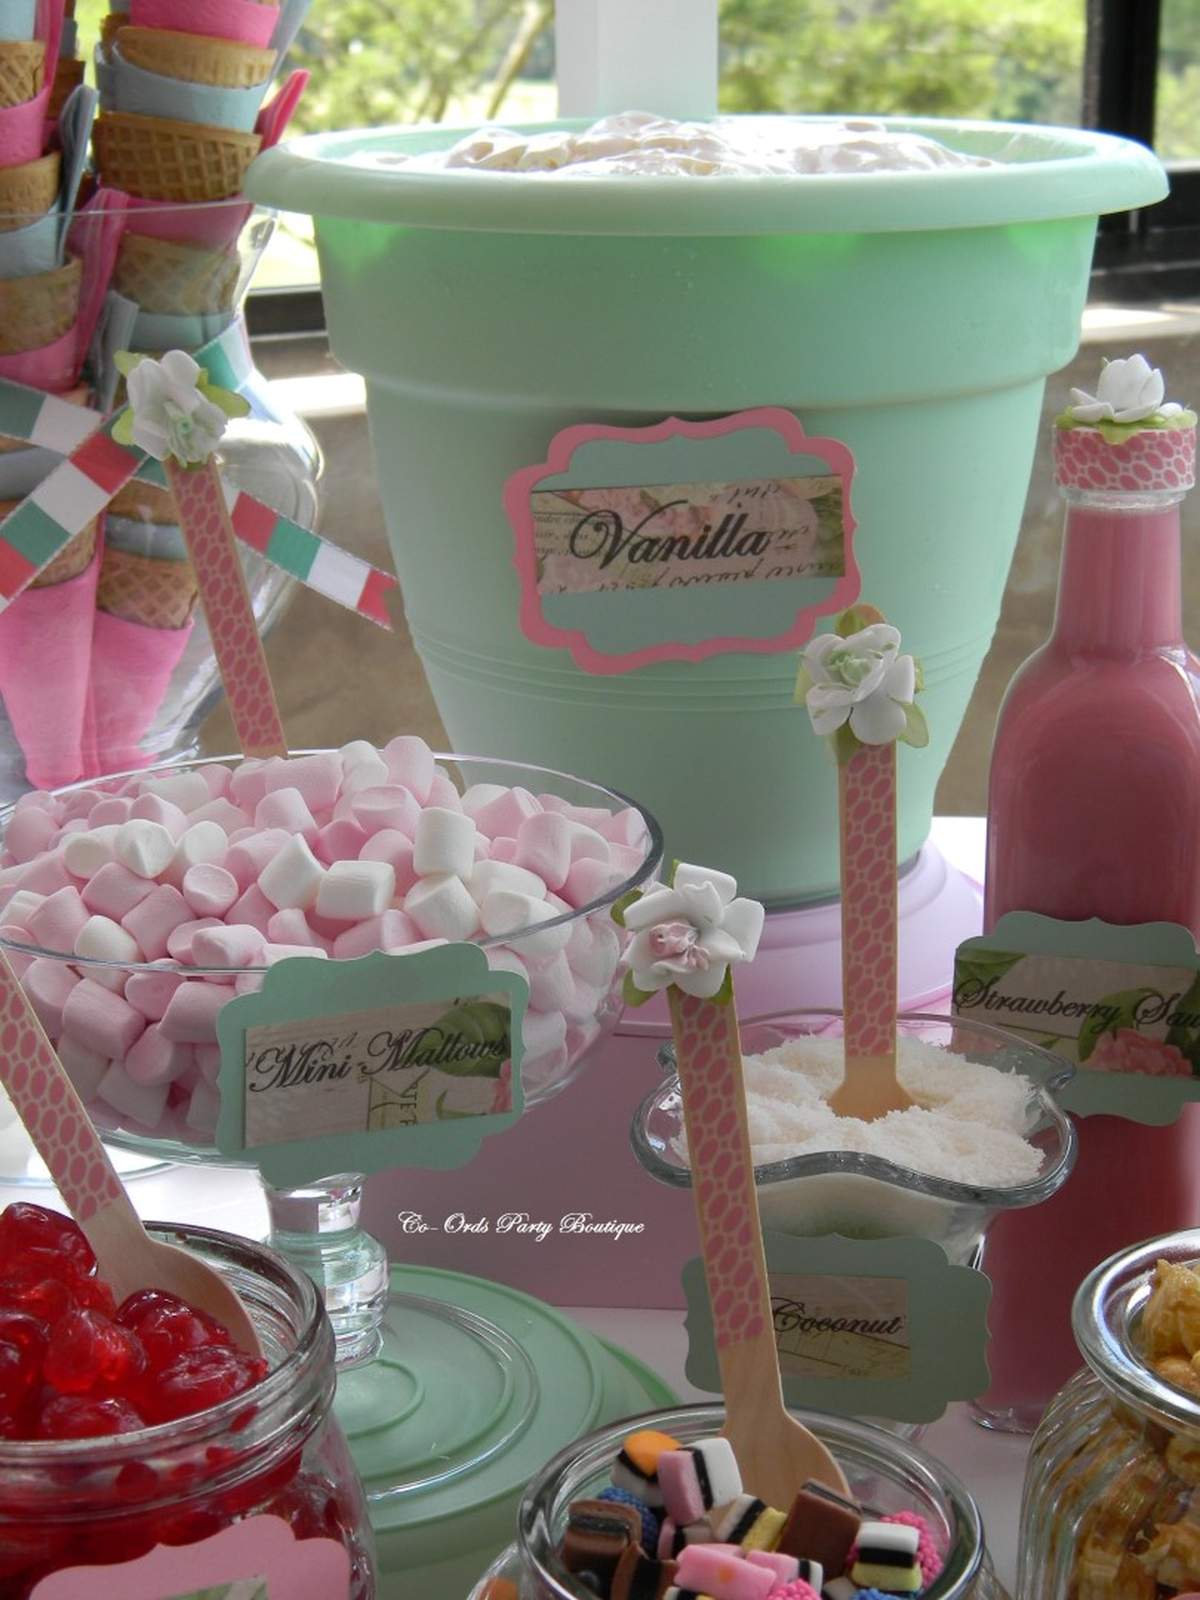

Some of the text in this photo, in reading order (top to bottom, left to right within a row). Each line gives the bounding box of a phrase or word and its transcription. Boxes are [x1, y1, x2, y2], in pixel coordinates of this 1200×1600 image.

[569, 499, 772, 571] Vanilla
[954, 976, 1121, 1033] Strawberry
[249, 1027, 510, 1093] Mini Mallows
[770, 1296, 904, 1335] Coconut
